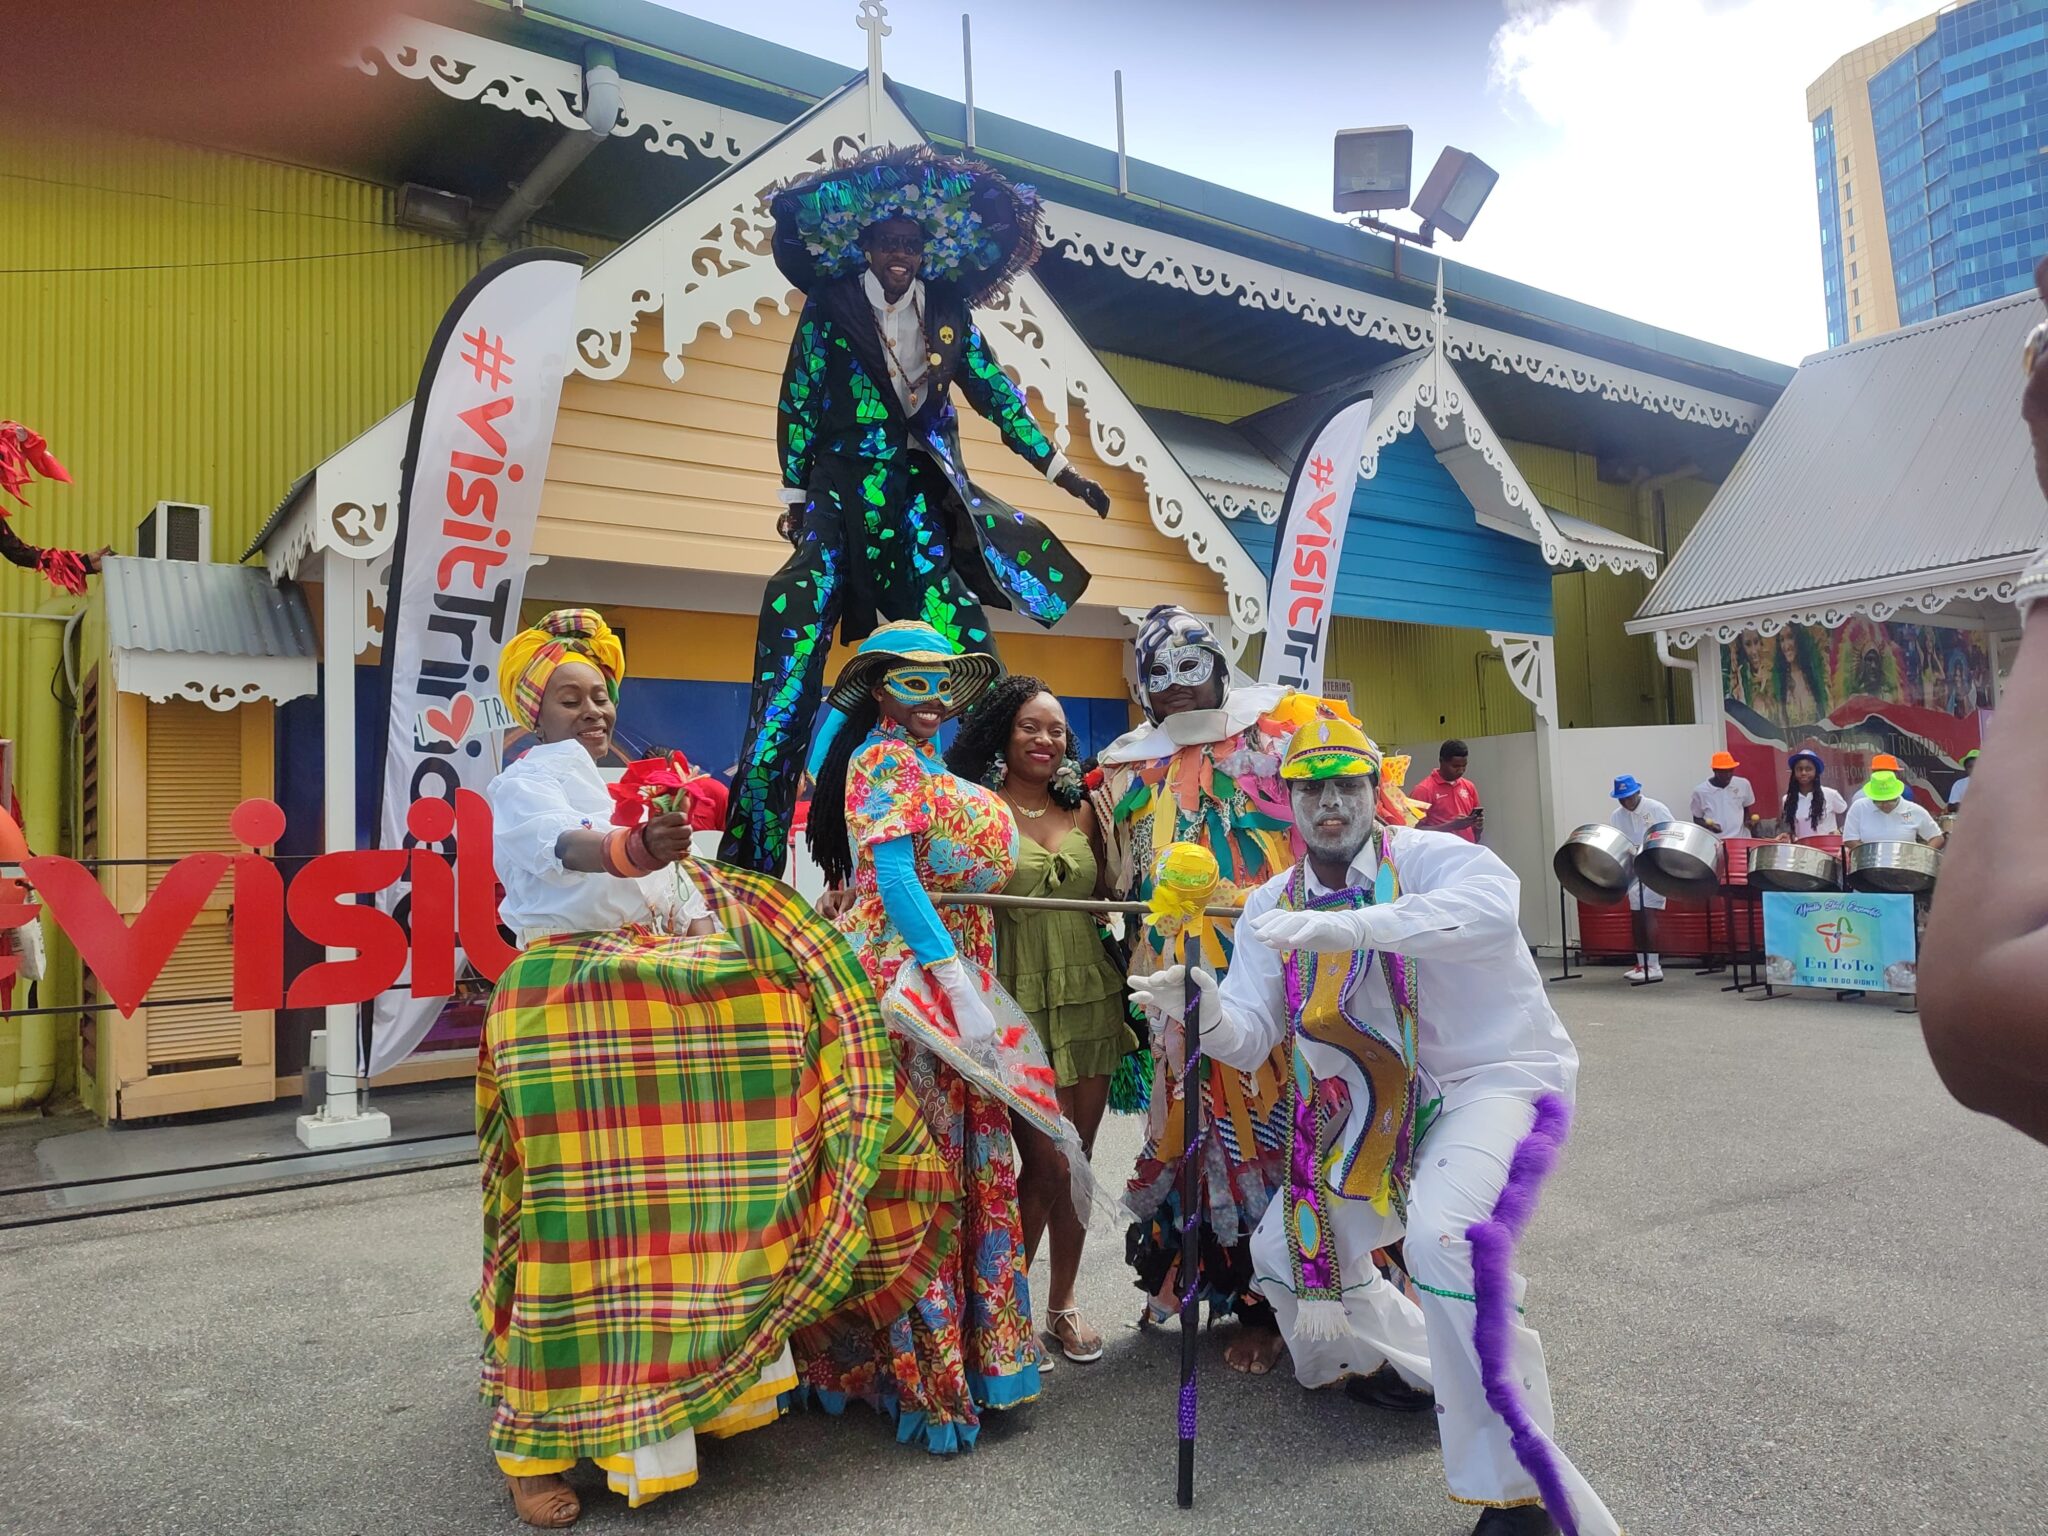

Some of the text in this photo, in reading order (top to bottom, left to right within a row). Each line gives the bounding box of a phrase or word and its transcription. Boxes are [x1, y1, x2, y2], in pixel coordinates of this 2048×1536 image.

[1278, 453, 1337, 691] #visitTri
[478, 697, 516, 729] TRI
[1888, 732, 1954, 756] TRINIDAD
[1805, 957, 1827, 969] En
